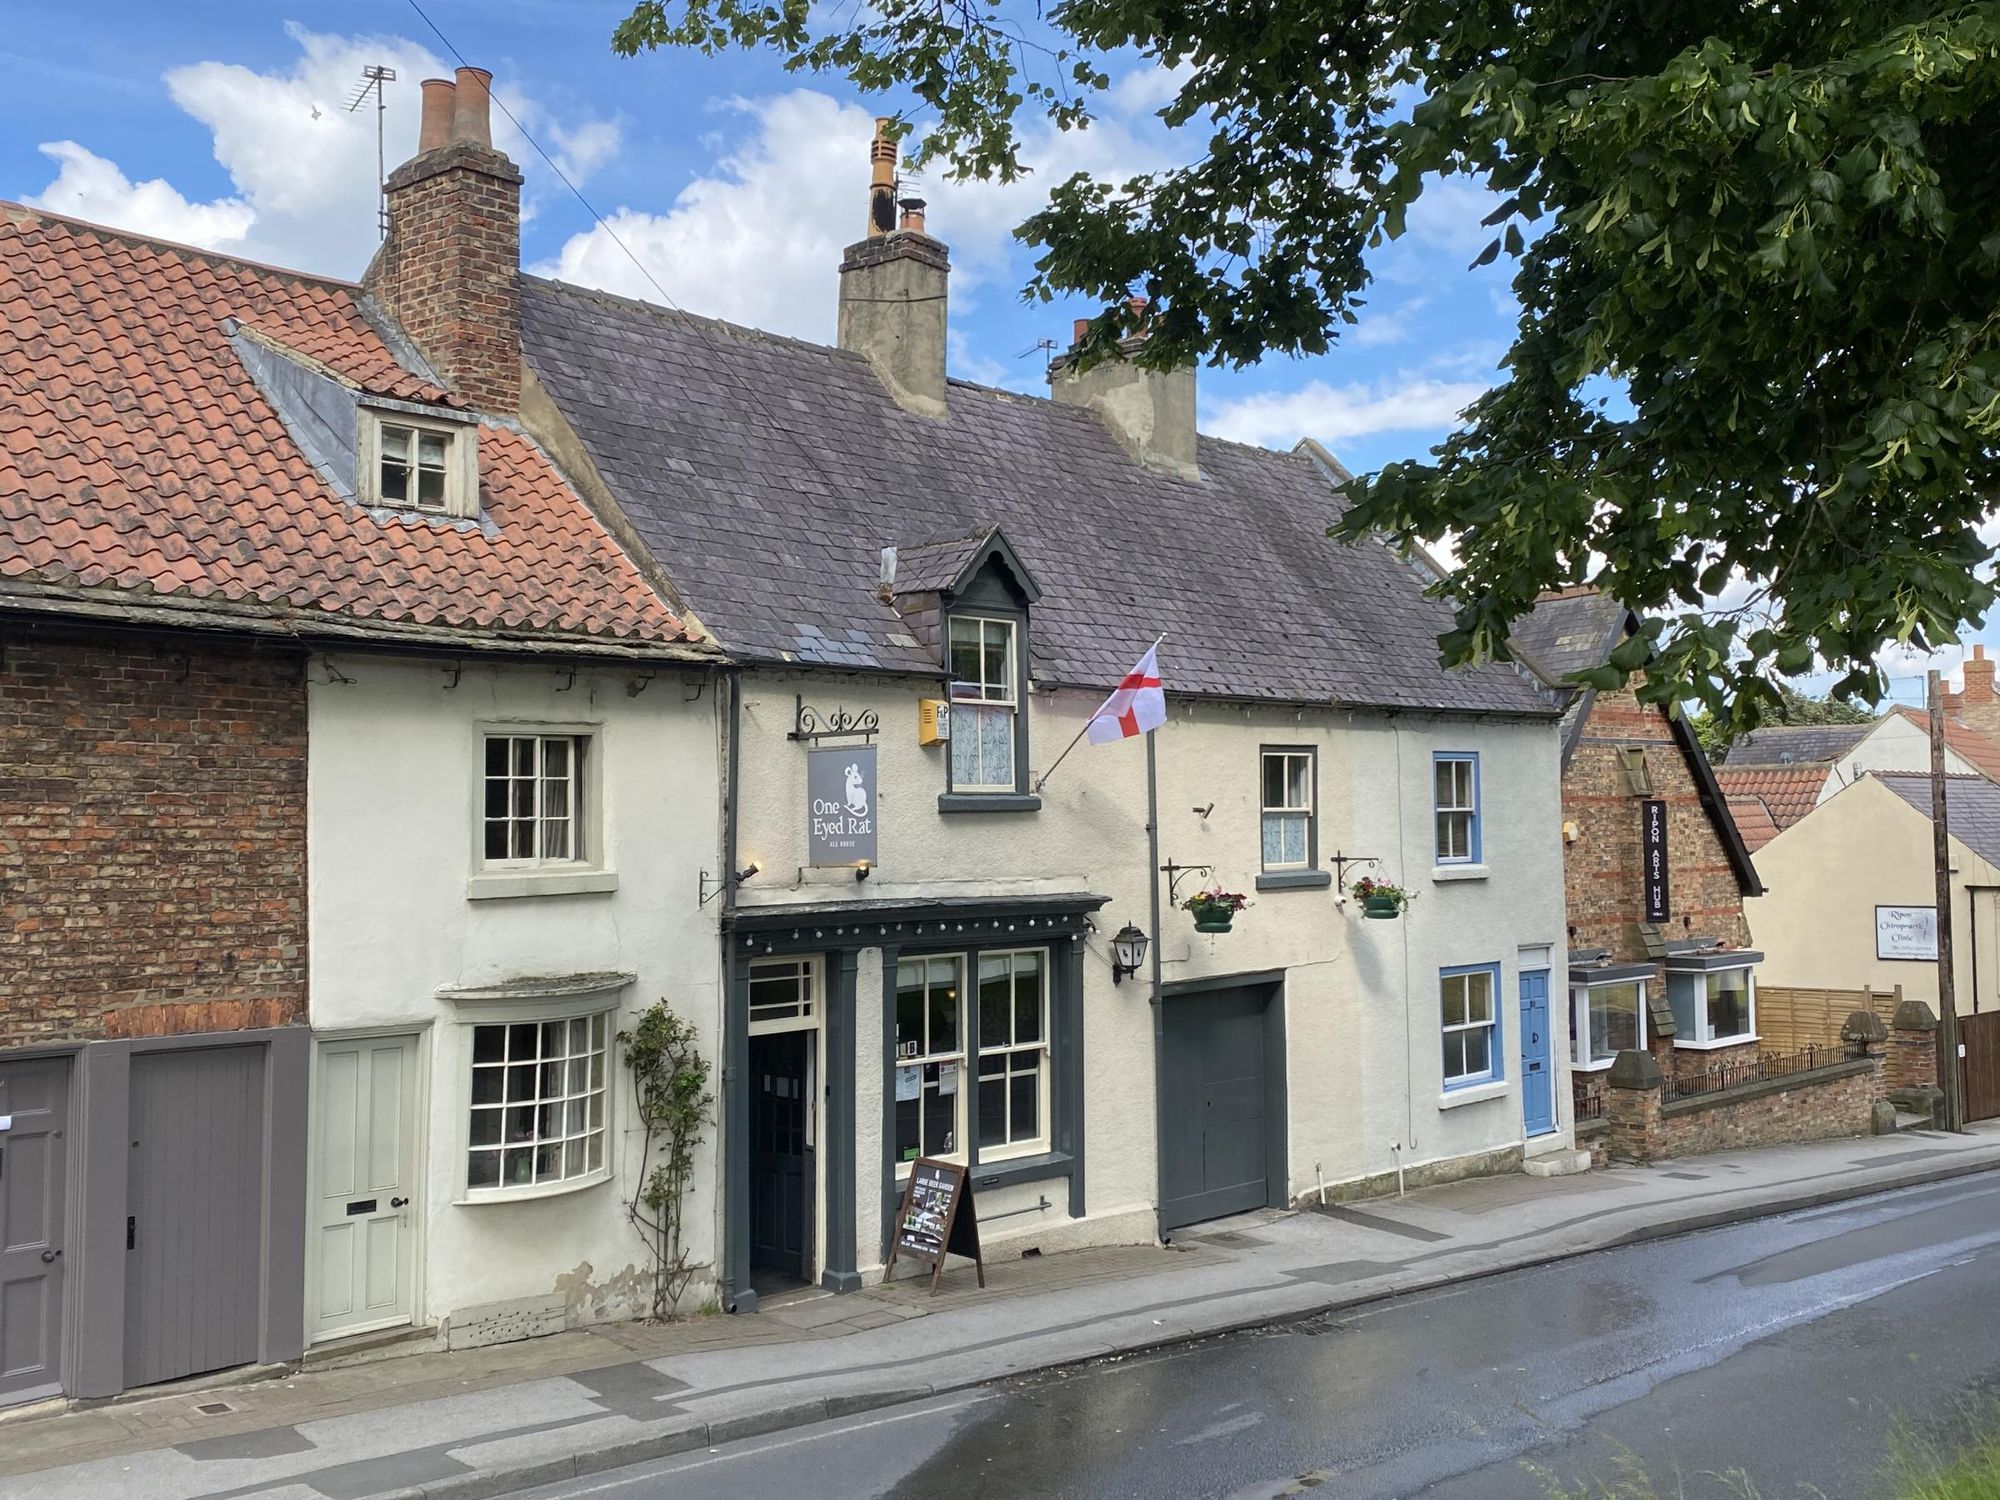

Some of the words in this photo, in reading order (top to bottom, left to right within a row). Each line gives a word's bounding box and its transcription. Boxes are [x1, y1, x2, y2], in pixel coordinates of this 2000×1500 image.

[936, 706, 948, 718] F&P
[813, 798, 840, 815] One
[813, 815, 845, 841] Eyed
[847, 817, 872, 835] Rat
[1651, 806, 1660, 843] RIPON
[1652, 849, 1661, 880] ARTS
[1653, 885, 1662, 909] HUB
[1888, 910, 1912, 920] Ripon
[1880, 921, 1924, 931] Chiropractic
[1891, 934, 1914, 942] Clinic
[916, 1177, 929, 1186] LARGE
[929, 1179, 939, 1188] BEER
[939, 1182, 954, 1192] GARDEN
